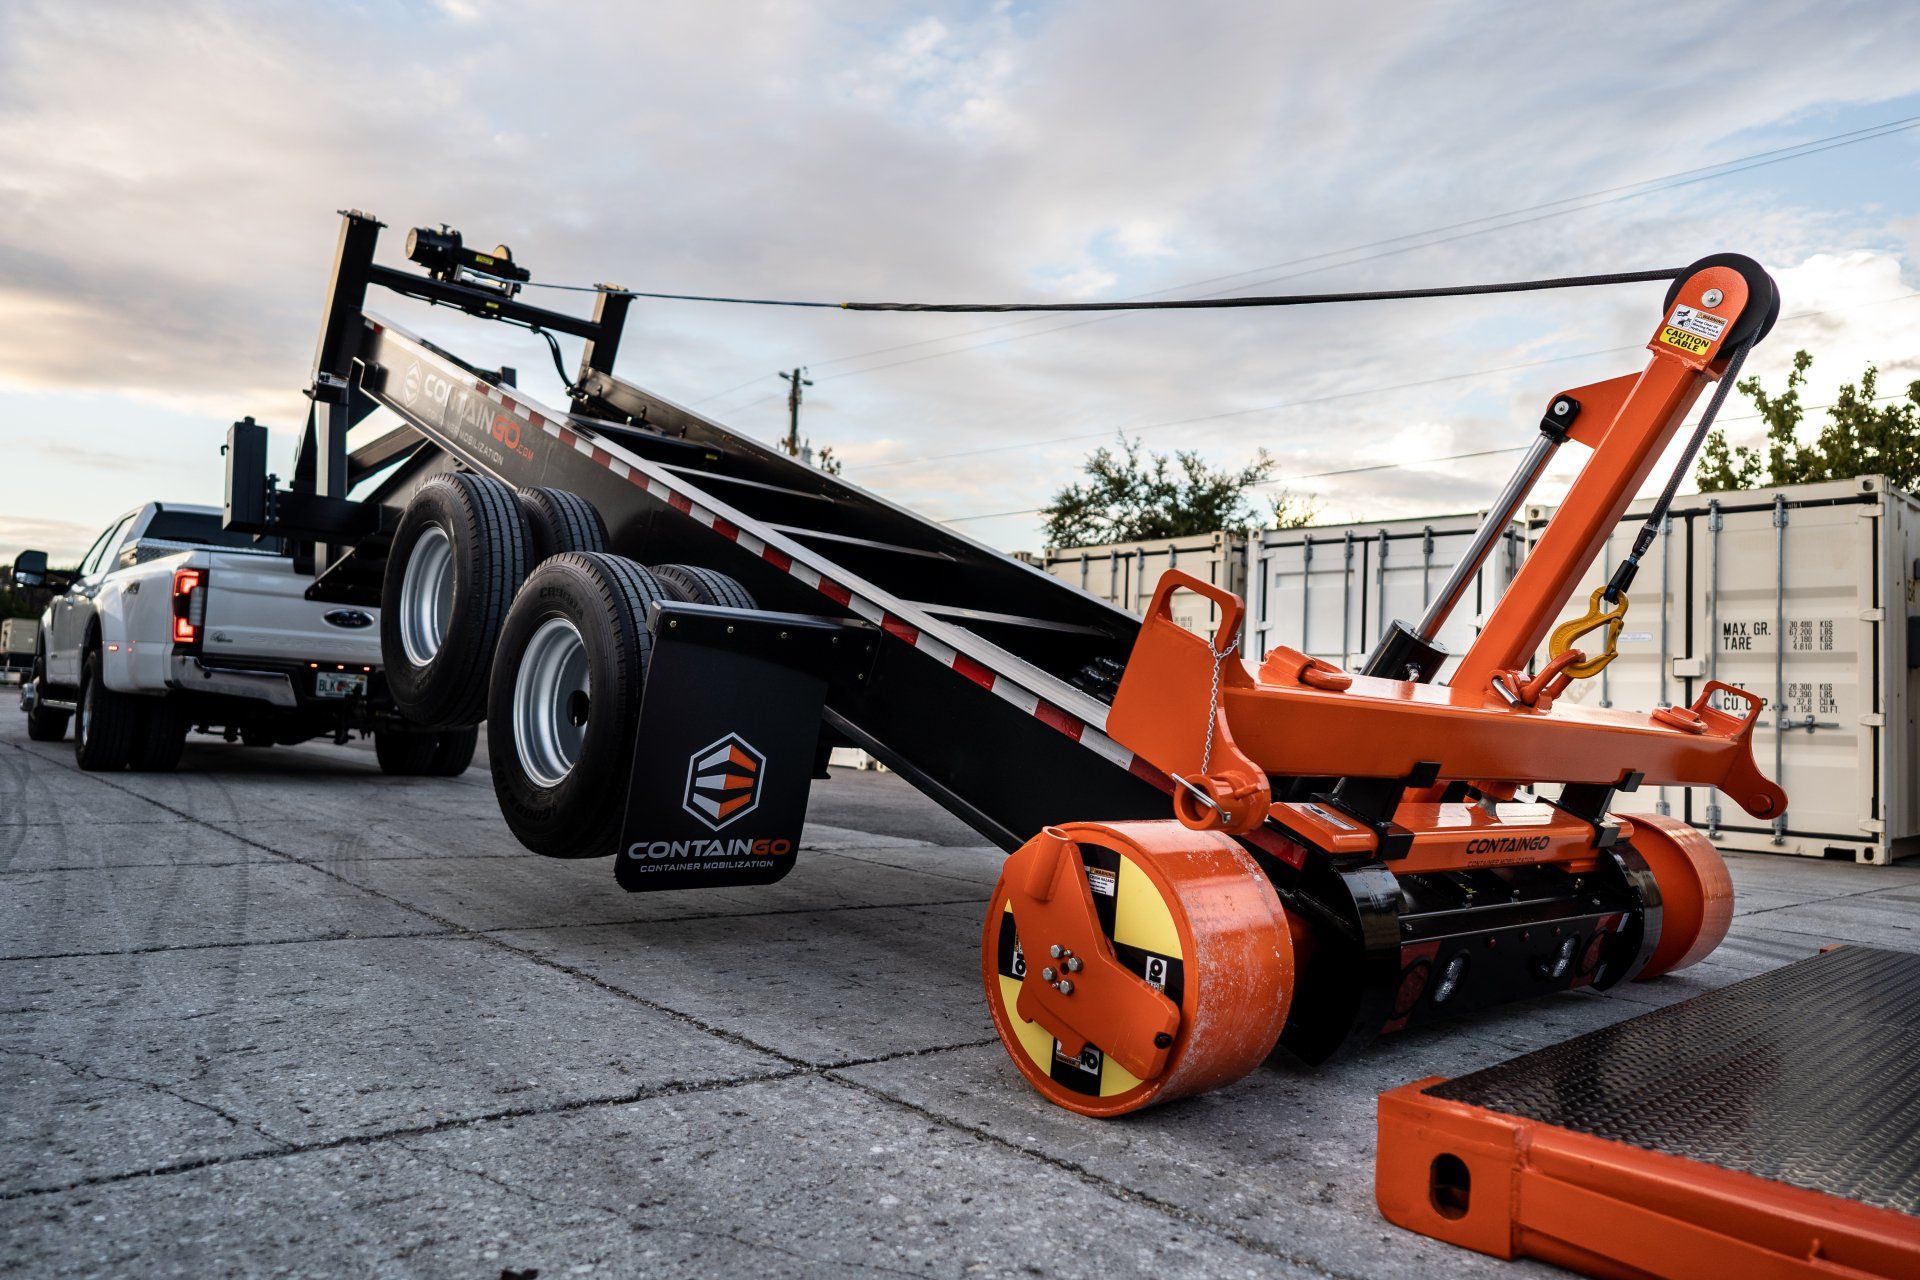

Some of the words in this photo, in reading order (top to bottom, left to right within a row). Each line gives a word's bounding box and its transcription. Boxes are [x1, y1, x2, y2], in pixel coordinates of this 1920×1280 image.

[1666, 328, 1709, 348] CAUTION
[1668, 336, 1700, 352] CABLE
[459, 429, 504, 466] MOBILIZATION
[1723, 622, 1750, 636] MAX.
[1753, 622, 1771, 636] GR.
[1819, 620, 1833, 628] KGS
[1723, 637, 1752, 650] TARE
[1819, 635, 1833, 643] KGS
[1819, 643, 1833, 651] LBS
[1819, 683, 1833, 691] KGS
[1723, 697, 1742, 711] CU.
[1745, 698, 1772, 712] CP.
[628, 838, 791, 860] CONTAINGO
[1465, 835, 1551, 855] CONTAINGO
[640, 862, 701, 873] CONTAINER
[703, 860, 774, 870] MOBILIZATION
